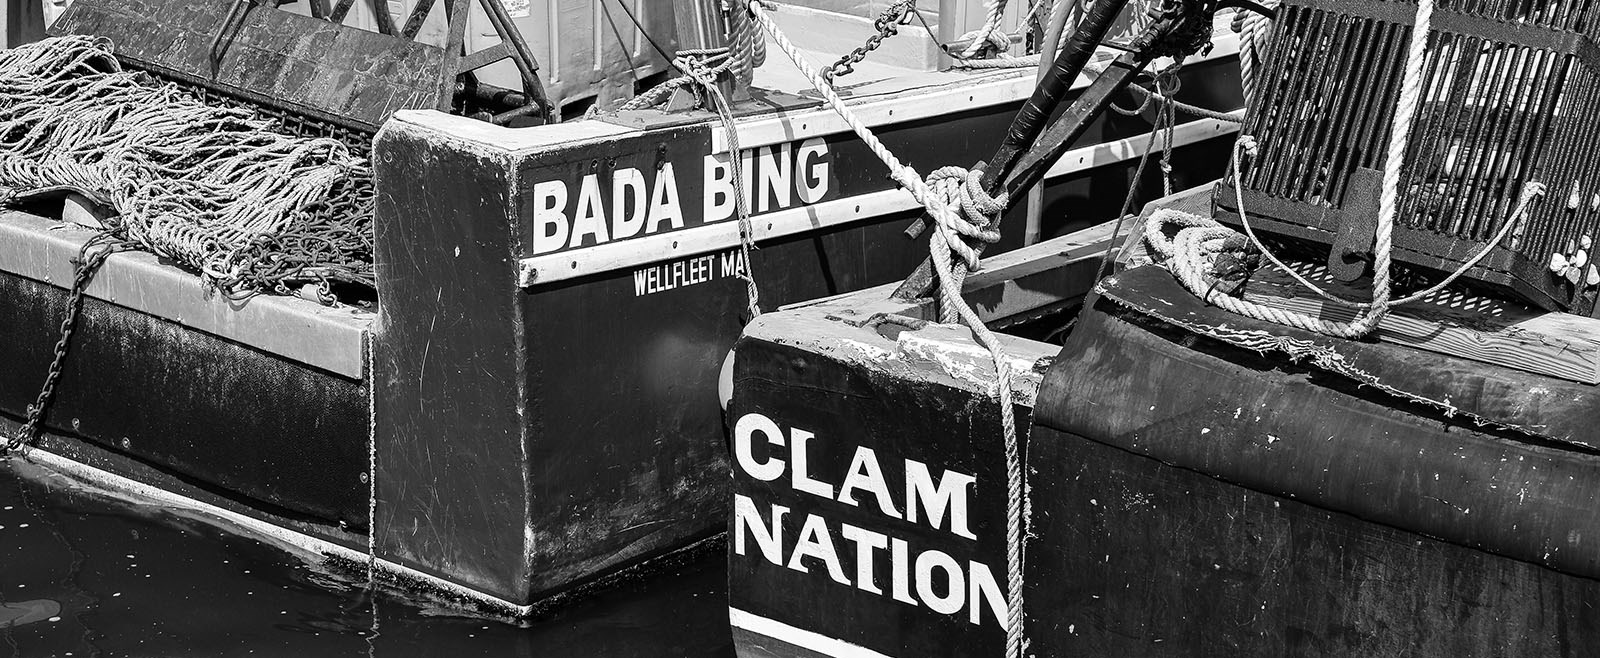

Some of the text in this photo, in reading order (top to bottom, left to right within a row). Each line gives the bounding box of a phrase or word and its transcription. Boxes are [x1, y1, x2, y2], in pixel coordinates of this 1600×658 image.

[533, 137, 829, 254] BADA BING
[633, 249, 745, 297] WELLFLEET MA
[735, 413, 978, 541] CLAM
[735, 493, 1009, 633] NATION
